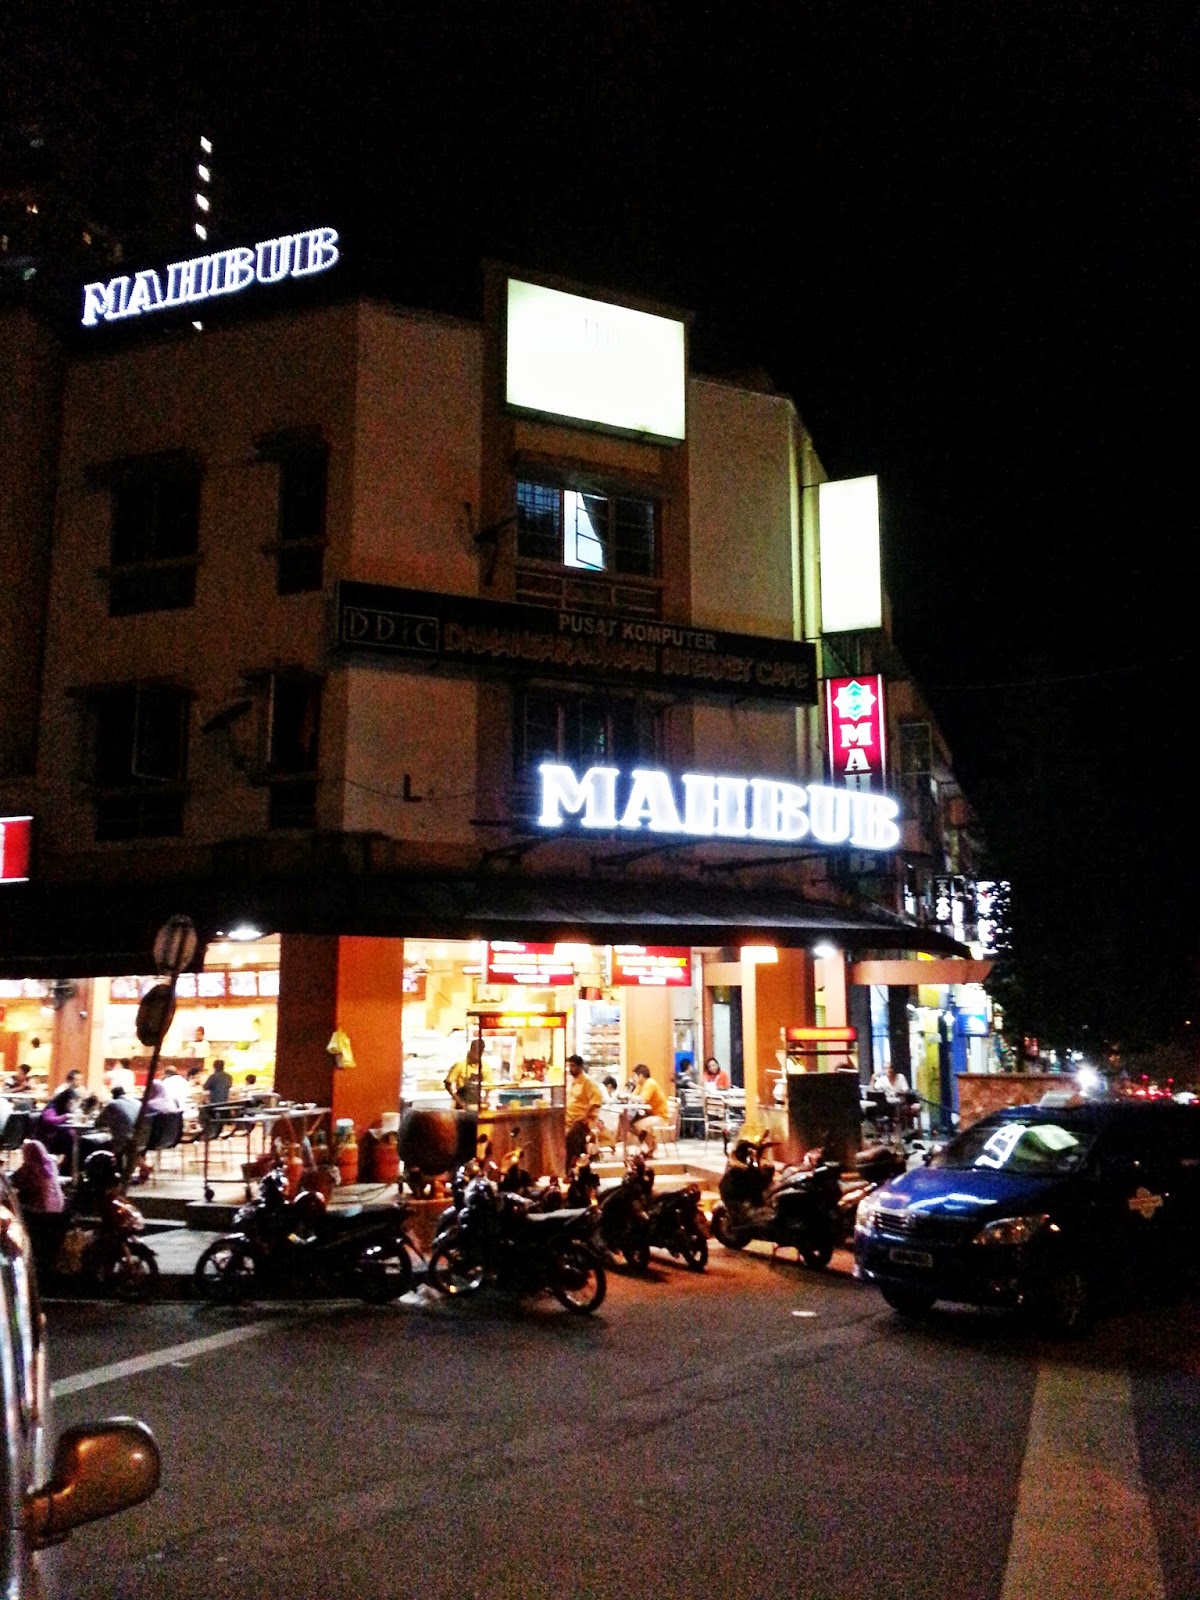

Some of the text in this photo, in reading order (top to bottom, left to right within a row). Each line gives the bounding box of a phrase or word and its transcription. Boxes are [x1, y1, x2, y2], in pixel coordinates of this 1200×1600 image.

[81, 227, 340, 326] MAHBUB
[559, 613, 716, 651] PUSAT KOMPUTER
[537, 762, 902, 851] MAHBUB
